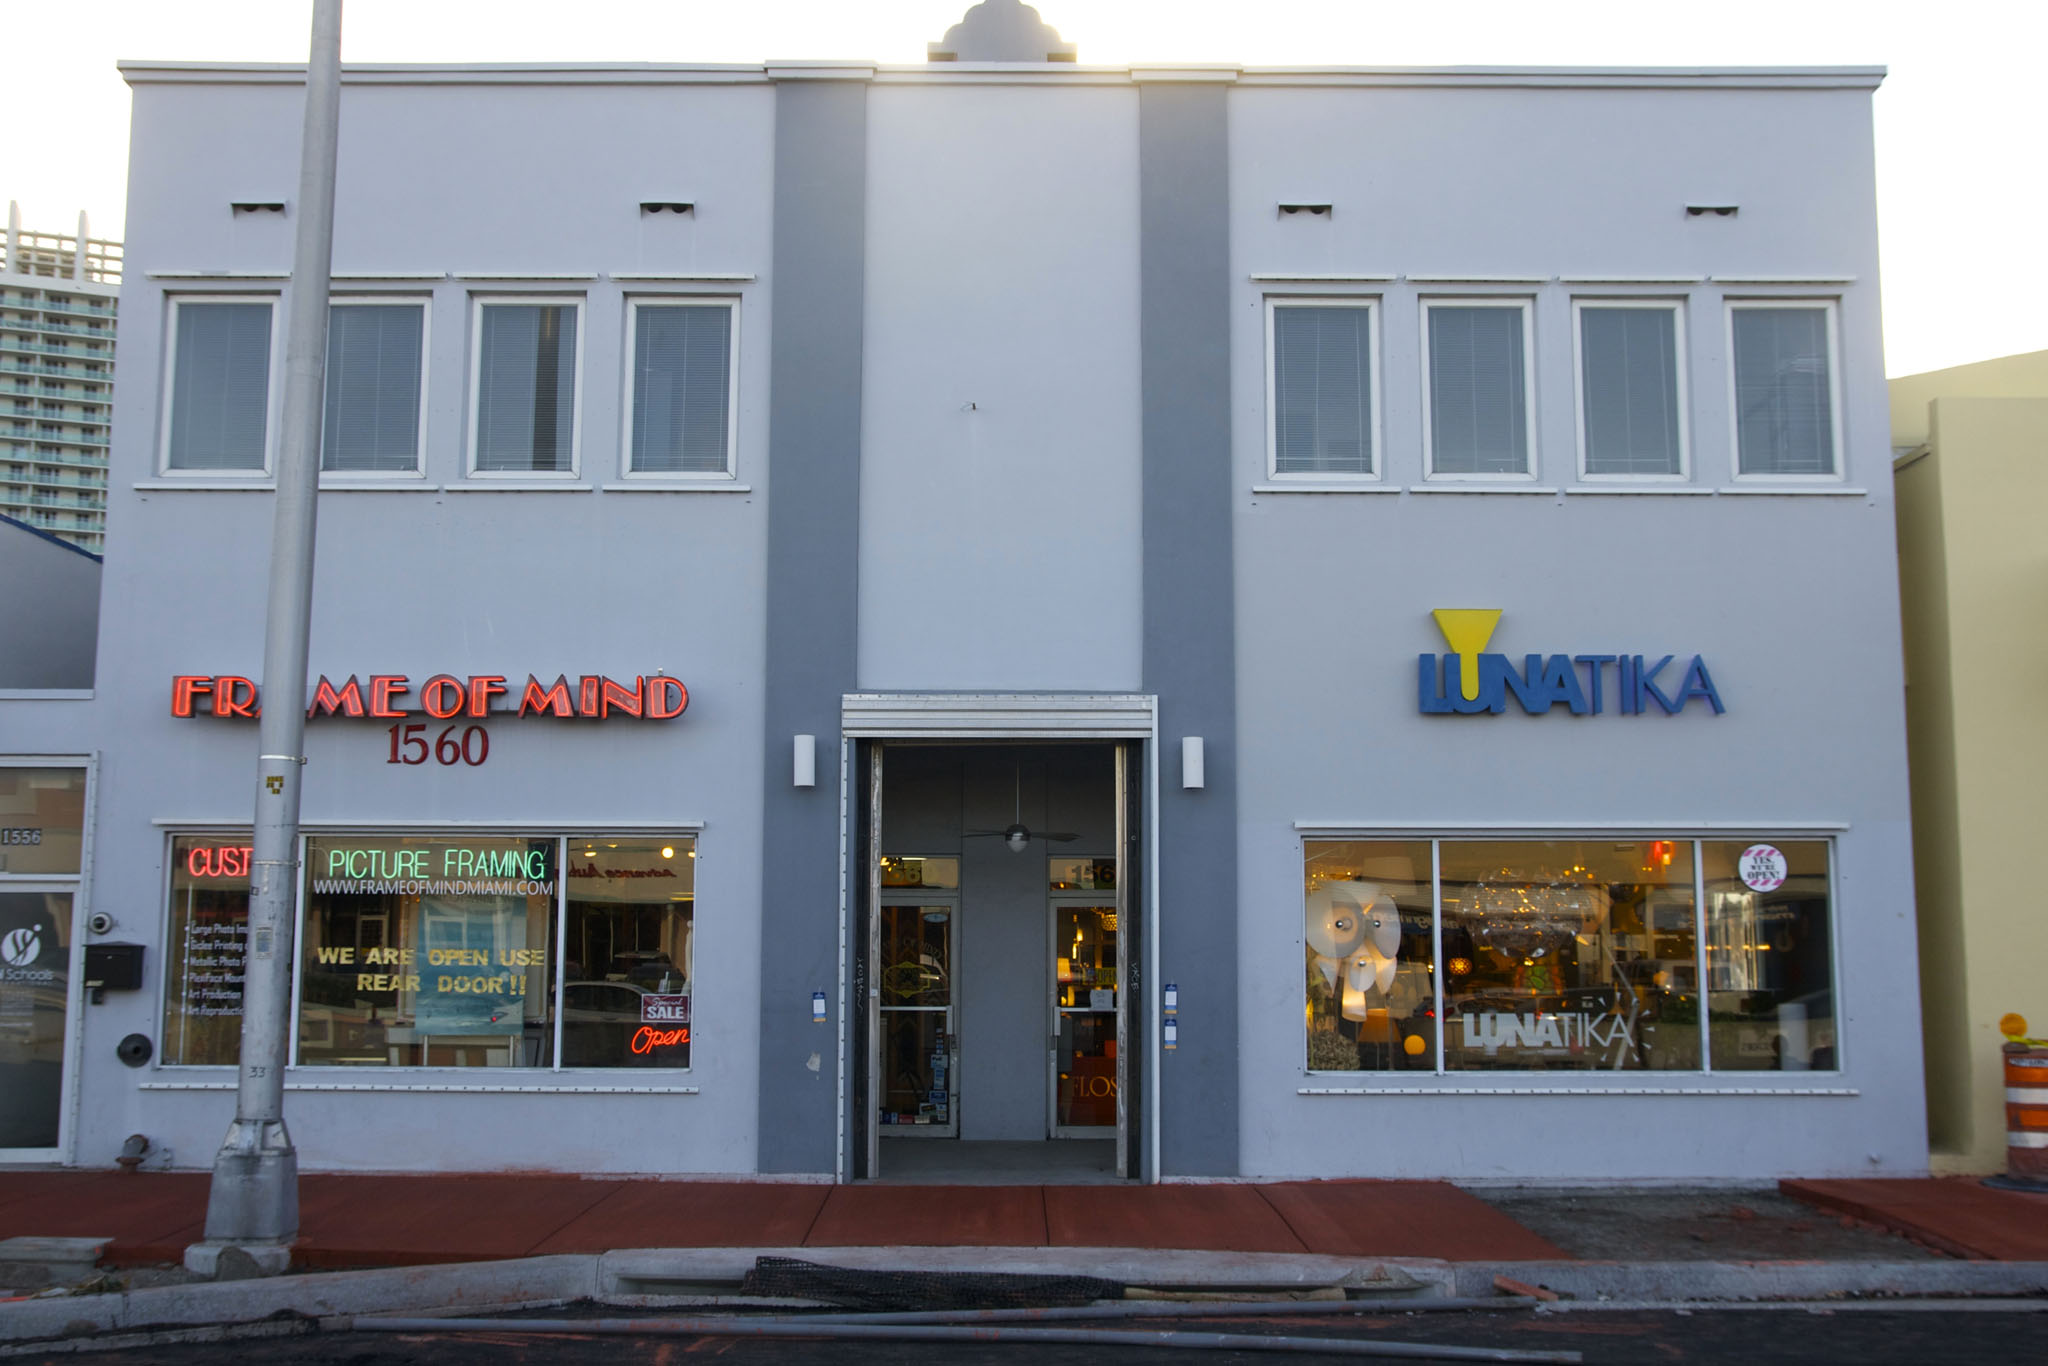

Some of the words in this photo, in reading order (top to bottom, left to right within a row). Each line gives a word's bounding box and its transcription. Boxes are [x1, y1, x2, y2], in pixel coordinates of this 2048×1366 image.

[171, 674, 409, 718] FRME
[421, 673, 507, 719] OF
[518, 673, 689, 719] MIND
[1418, 653, 1726, 715] LUNATIKA
[387, 724, 489, 766] 1560
[2, 828, 42, 845] 1556
[188, 847, 254, 877] CUST
[329, 849, 430, 878] PICTURE
[444, 849, 545, 879] FRAMING
[313, 879, 553, 895] WWW.FRAMEOFMINDMIAMI.COM
[318, 947, 355, 965] WE
[365, 947, 415, 965] ARE
[428, 949, 488, 966] OPEN
[499, 949, 545, 966] USE
[6, 968, 54, 981] Schools
[357, 974, 421, 992] REAR
[647, 1006, 685, 1020] SALE
[631, 1026, 690, 1054] Open
[1463, 1012, 1635, 1048] LUNATIKA
